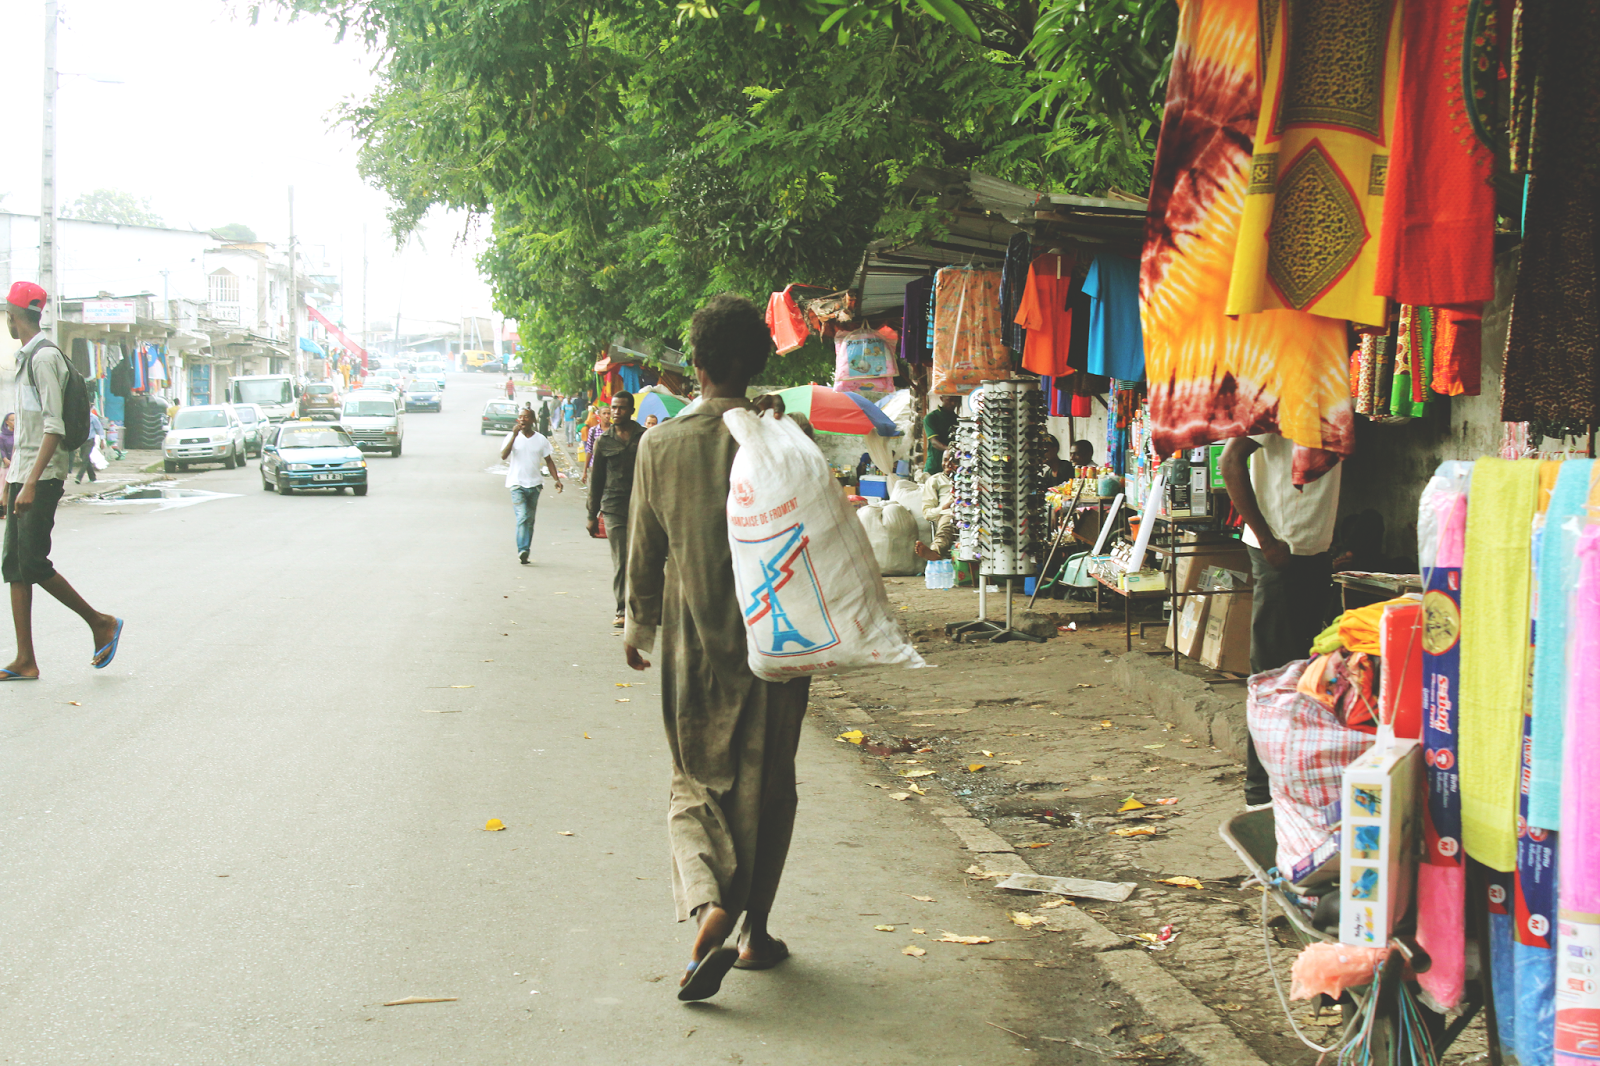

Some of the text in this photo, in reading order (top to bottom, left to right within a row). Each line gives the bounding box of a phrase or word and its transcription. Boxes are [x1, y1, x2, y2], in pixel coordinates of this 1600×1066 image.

[759, 512, 769, 525] DE
[768, 496, 799, 521] FROMENT
[1440, 840, 1449, 852] M
[1531, 918, 1540, 930] M
